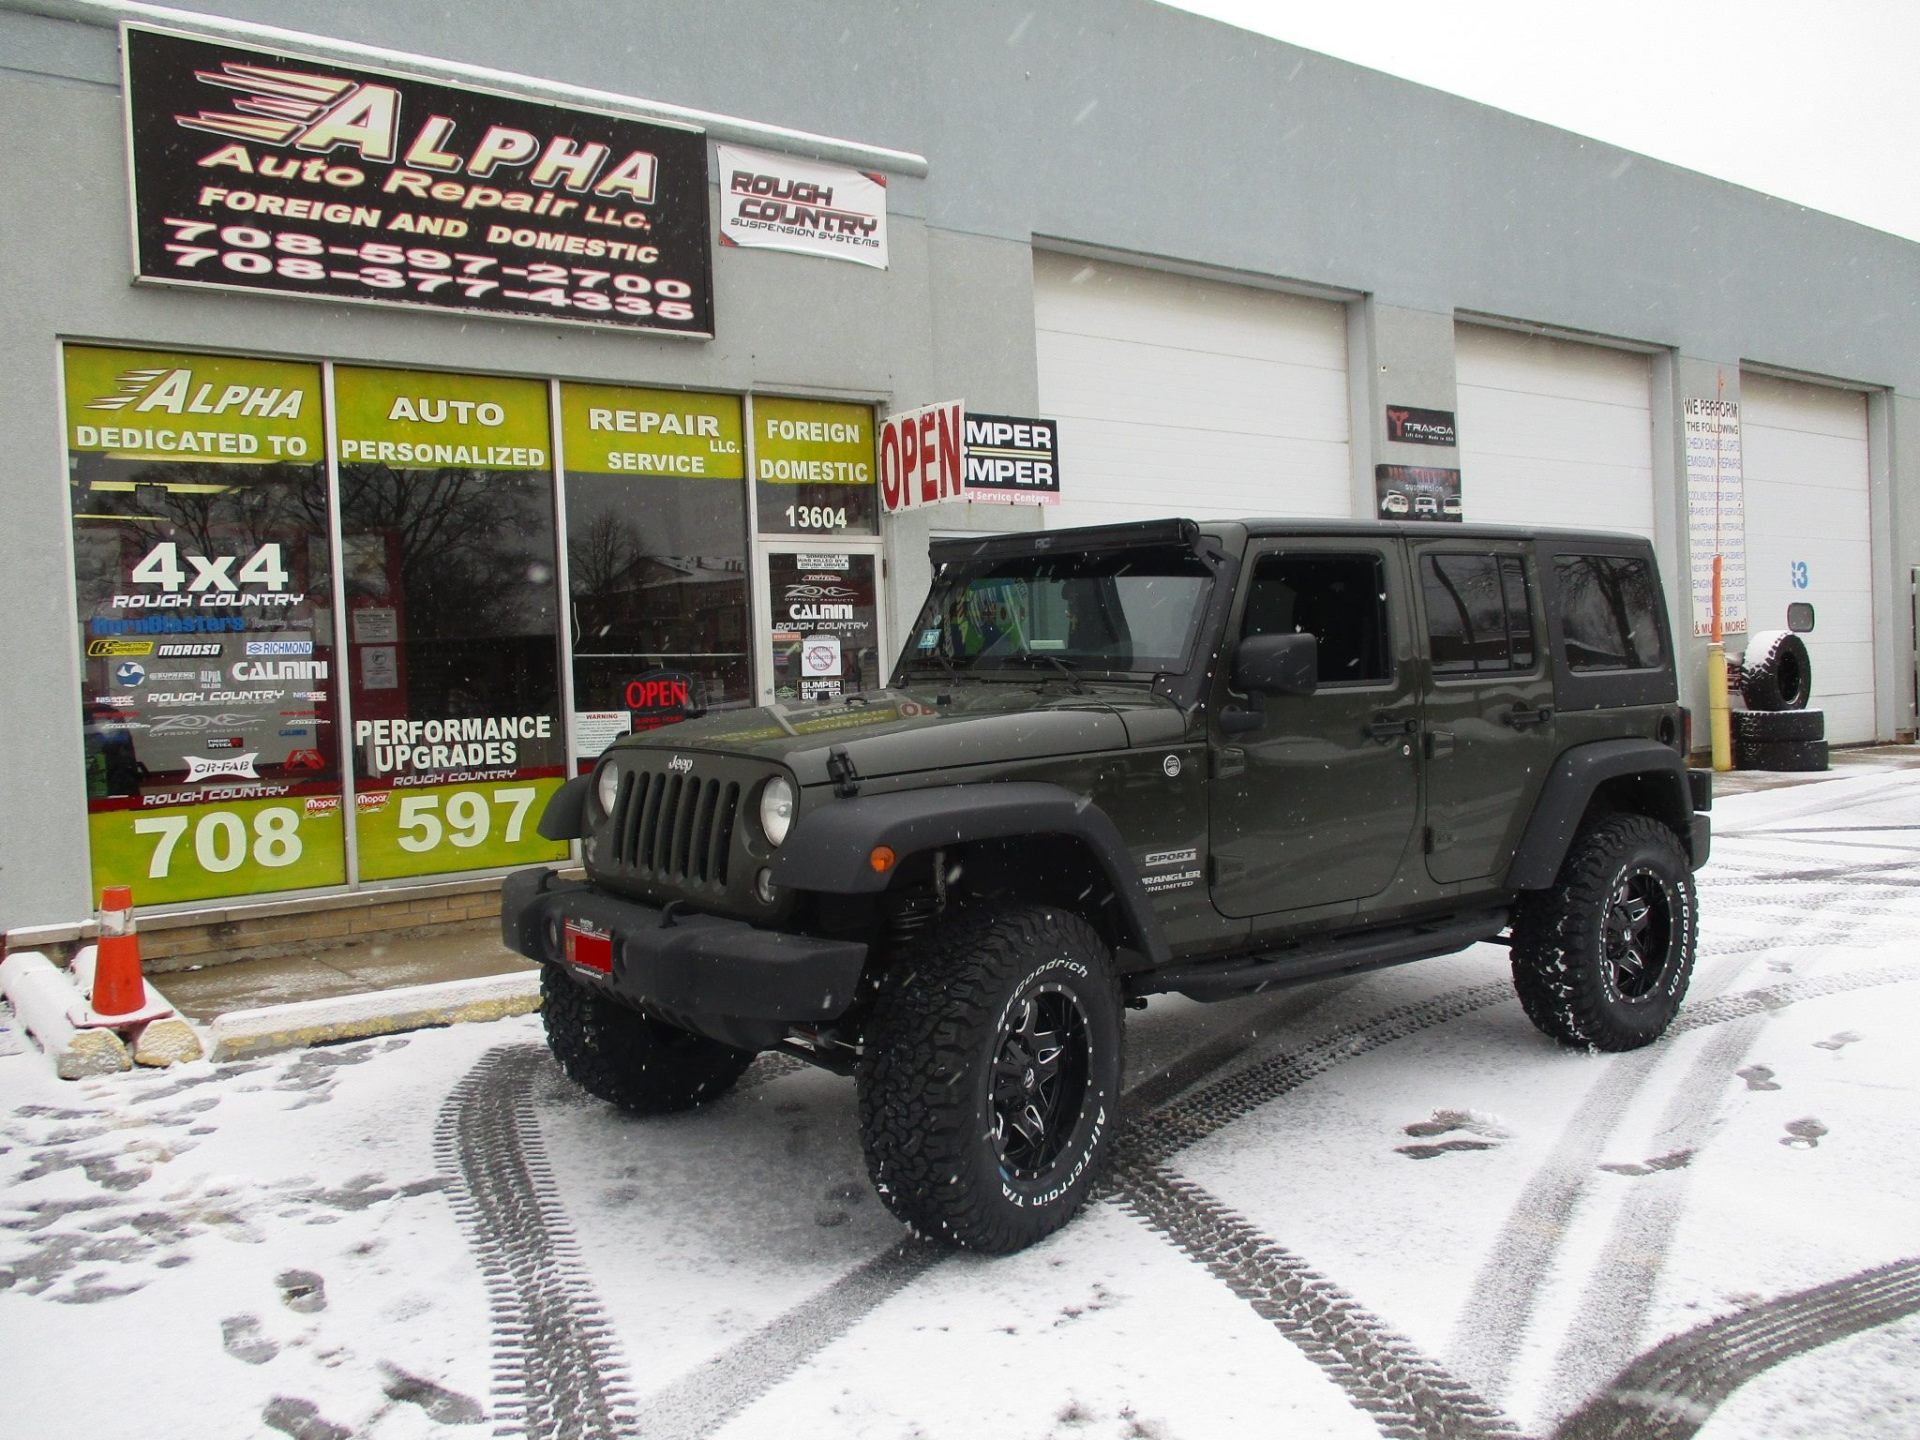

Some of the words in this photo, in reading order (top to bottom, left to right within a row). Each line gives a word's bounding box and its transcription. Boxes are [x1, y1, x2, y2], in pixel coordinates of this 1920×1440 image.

[294, 83, 657, 204] ALPHA
[197, 143, 365, 187] Auto
[383, 169, 579, 217] Repair
[584, 205, 651, 230] LLC.
[731, 170, 833, 206] ROUGH
[199, 186, 381, 228] FOREIGN
[387, 213, 468, 238] AND
[487, 225, 659, 263] DOMESTIC
[738, 198, 877, 237] COUNTRY
[730, 218, 815, 238] SUSPENSION
[818, 231, 880, 248] SYSTEMS
[164, 217, 691, 298] 708-597-2700
[165, 244, 694, 320] 708-377-4335
[134, 369, 303, 418] ALPHA
[389, 397, 505, 426] AUTO
[1684, 398, 1699, 415] WE
[1700, 400, 1738, 420] PERFORM
[589, 408, 720, 437] REPAIR
[767, 419, 860, 443] FOREIGN
[967, 420, 1051, 449] MPER
[1404, 422, 1454, 436] TRAXDA
[1686, 421, 1700, 432] THE
[1701, 423, 1739, 435] FOLLOWING
[76, 426, 258, 454] DEDICATED
[268, 435, 307, 456] TO
[342, 440, 545, 466] PERSONALIZED
[710, 440, 740, 454] LLC.
[608, 452, 705, 473] SERVICE
[881, 405, 961, 511] OPEN
[760, 459, 868, 482] DOMESTIC
[967, 458, 1053, 485] MPER
[785, 505, 847, 529] 13604
[131, 542, 289, 592] 4x4
[112, 594, 192, 608] ROUGH
[200, 593, 304, 608] COUNTRY
[789, 604, 853, 620] CALMINI
[775, 622, 814, 631] ROUGH
[816, 621, 869, 630] COUNTRY
[263, 642, 311, 654] RICHMOND
[232, 661, 328, 681] CALMINI
[147, 692, 204, 702] ROUGH
[209, 690, 285, 701] COUNTRY
[625, 680, 688, 709] OPEN
[801, 681, 841, 689] BUMPER
[356, 716, 550, 746] PERFORMANCE
[194, 761, 249, 774] OR-FAB
[375, 741, 517, 772] UPGRADES
[668, 754, 693, 774] Jeep
[393, 773, 444, 787] ROUGH
[447, 769, 517, 783] COUNTRY
[143, 792, 203, 805] ROUGH
[209, 786, 289, 800] COUNTRY
[306, 799, 337, 809] Mopar
[357, 795, 387, 804] Mopar
[397, 787, 536, 853] 597
[134, 807, 303, 878] 708
[1147, 851, 1193, 863] SPORT
[1142, 870, 1201, 884] WRANGLER
[1145, 881, 1194, 893] UNLIMITED
